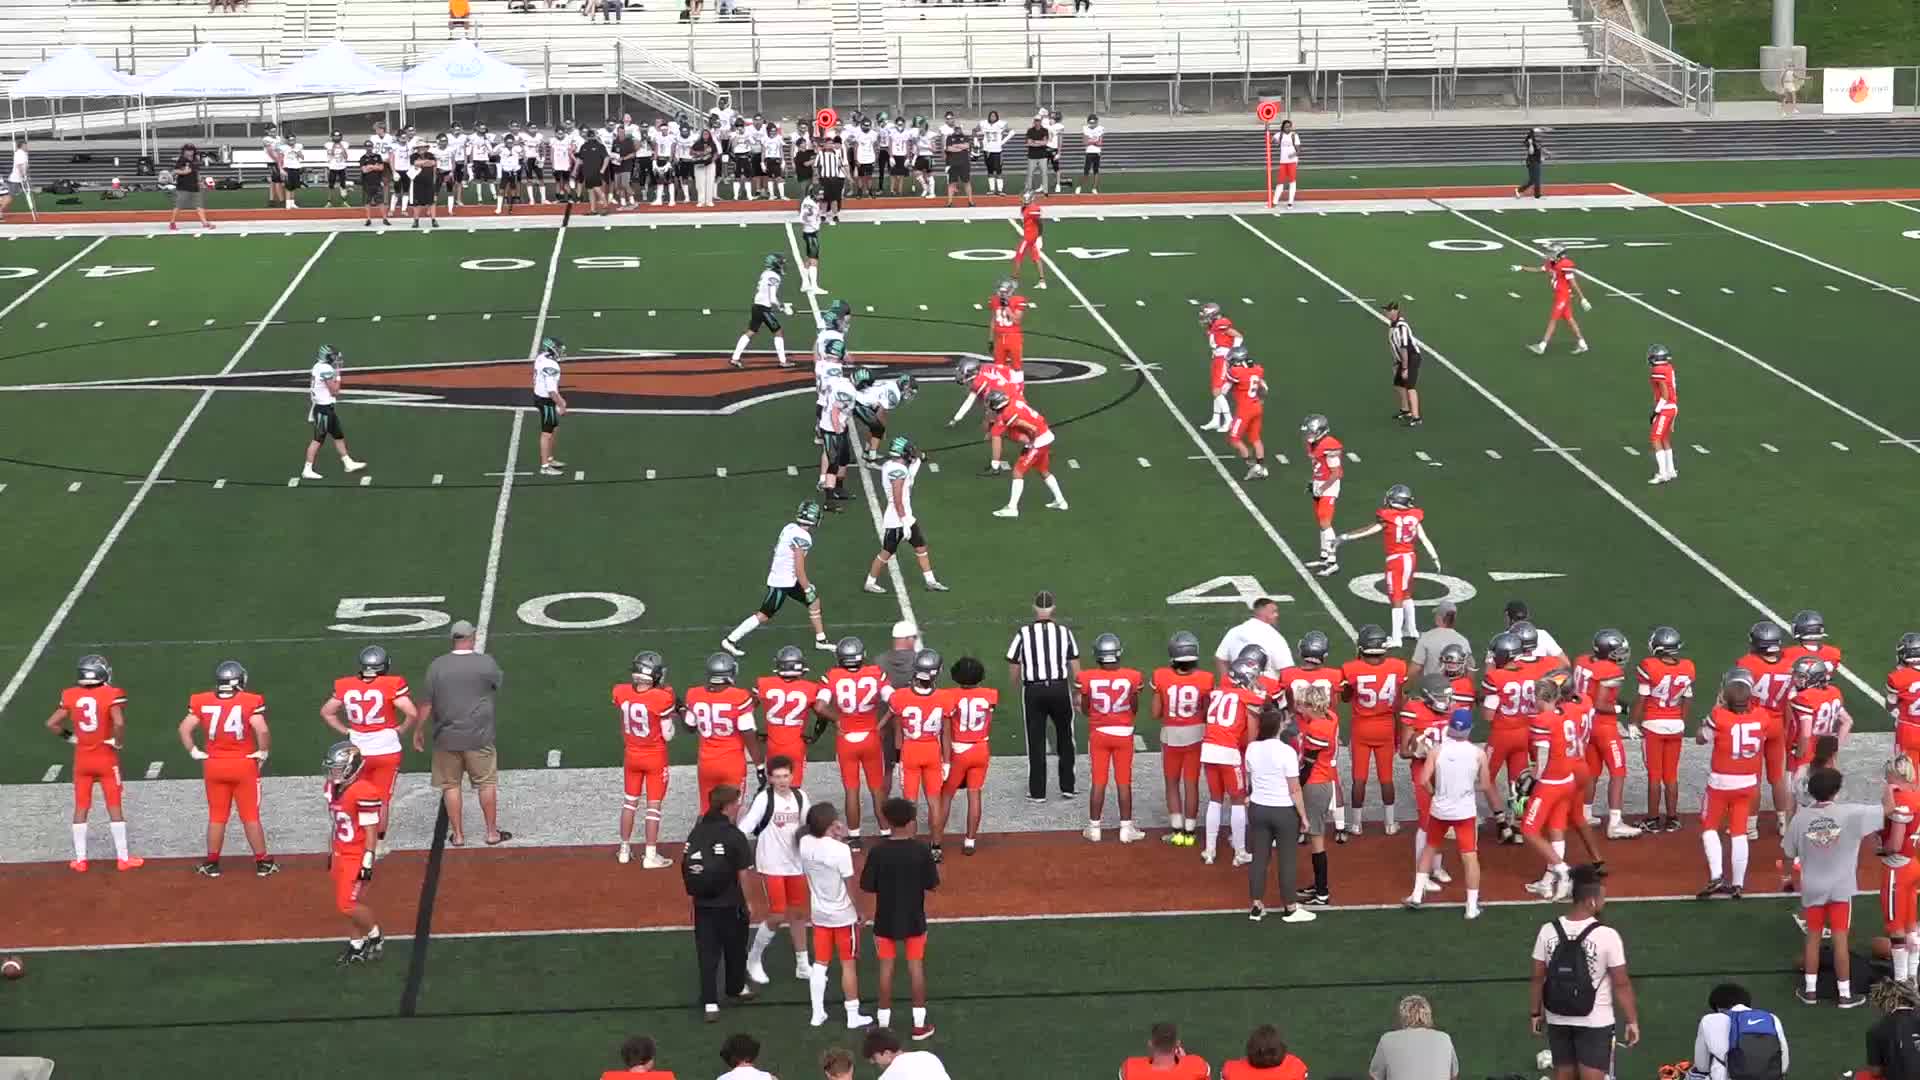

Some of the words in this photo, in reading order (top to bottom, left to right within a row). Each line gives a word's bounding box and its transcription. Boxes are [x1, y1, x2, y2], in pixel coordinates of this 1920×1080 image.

[1394, 515, 1417, 544] 13
[343, 689, 385, 725] 62
[766, 688, 808, 727] 22
[836, 676, 878, 714] 82
[1090, 679, 1131, 714] 52
[1167, 684, 1199, 718] 18
[1357, 674, 1397, 708] 54
[1652, 674, 1692, 708] 42
[1751, 673, 1793, 708] 47
[75, 696, 98, 732] 3
[201, 704, 244, 741] 74
[620, 700, 650, 738] 19
[902, 705, 943, 740] 34
[958, 697, 990, 732] 16
[1207, 690, 1240, 728] 20
[1730, 721, 1762, 759] 15
